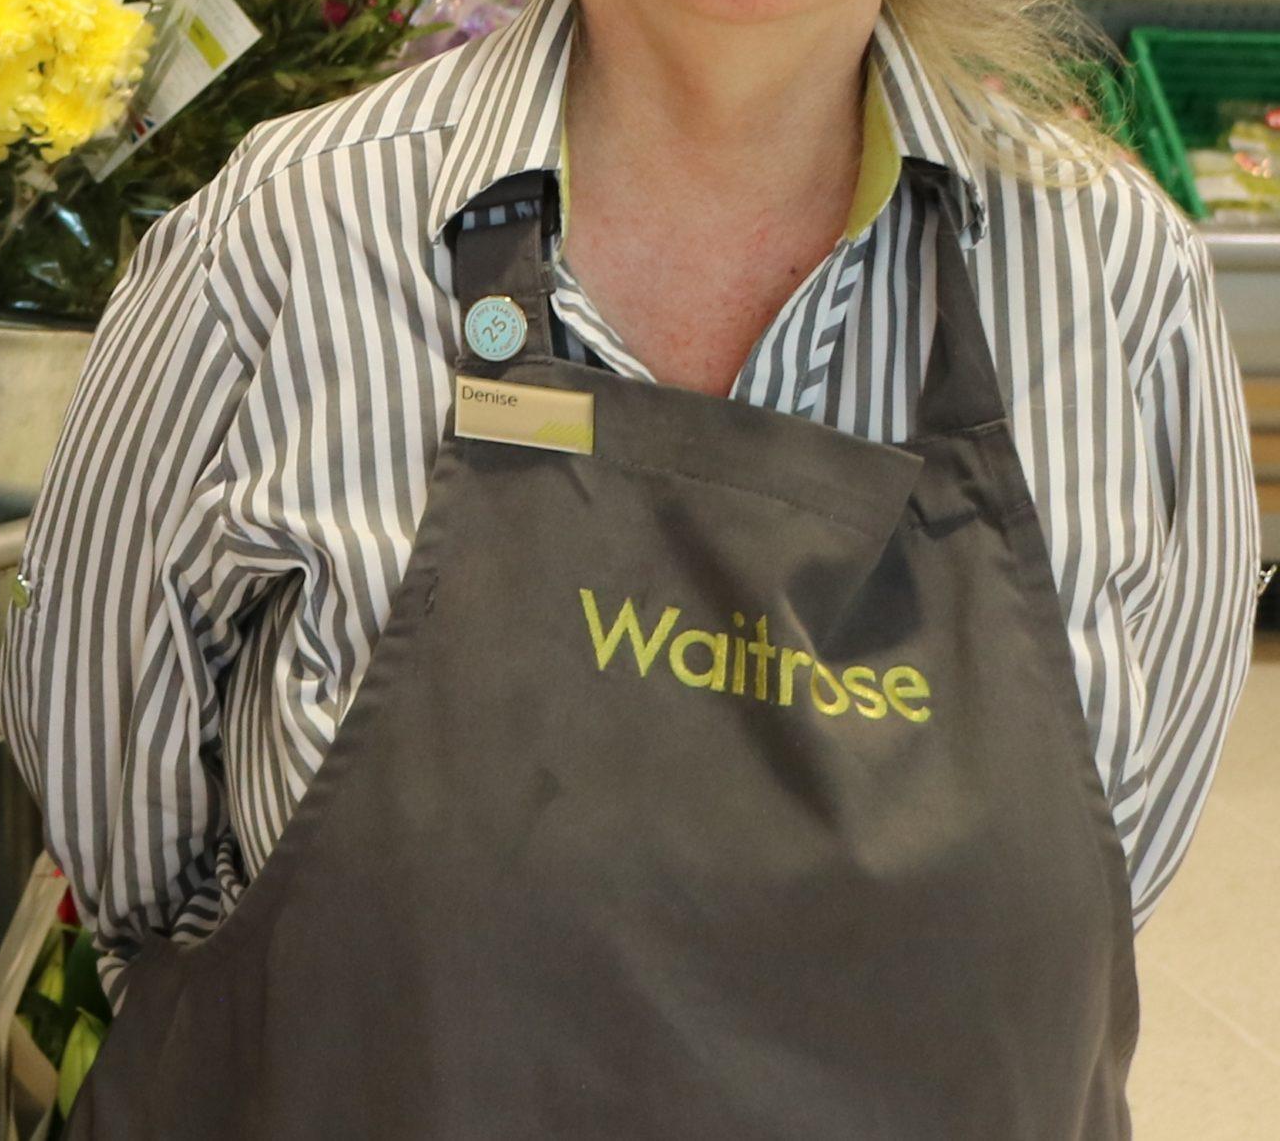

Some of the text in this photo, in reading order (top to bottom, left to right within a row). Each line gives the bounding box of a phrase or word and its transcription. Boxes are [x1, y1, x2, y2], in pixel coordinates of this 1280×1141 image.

[482, 315, 507, 343] 25
[461, 385, 518, 406] Denise
[579, 588, 932, 723] Waitrose
